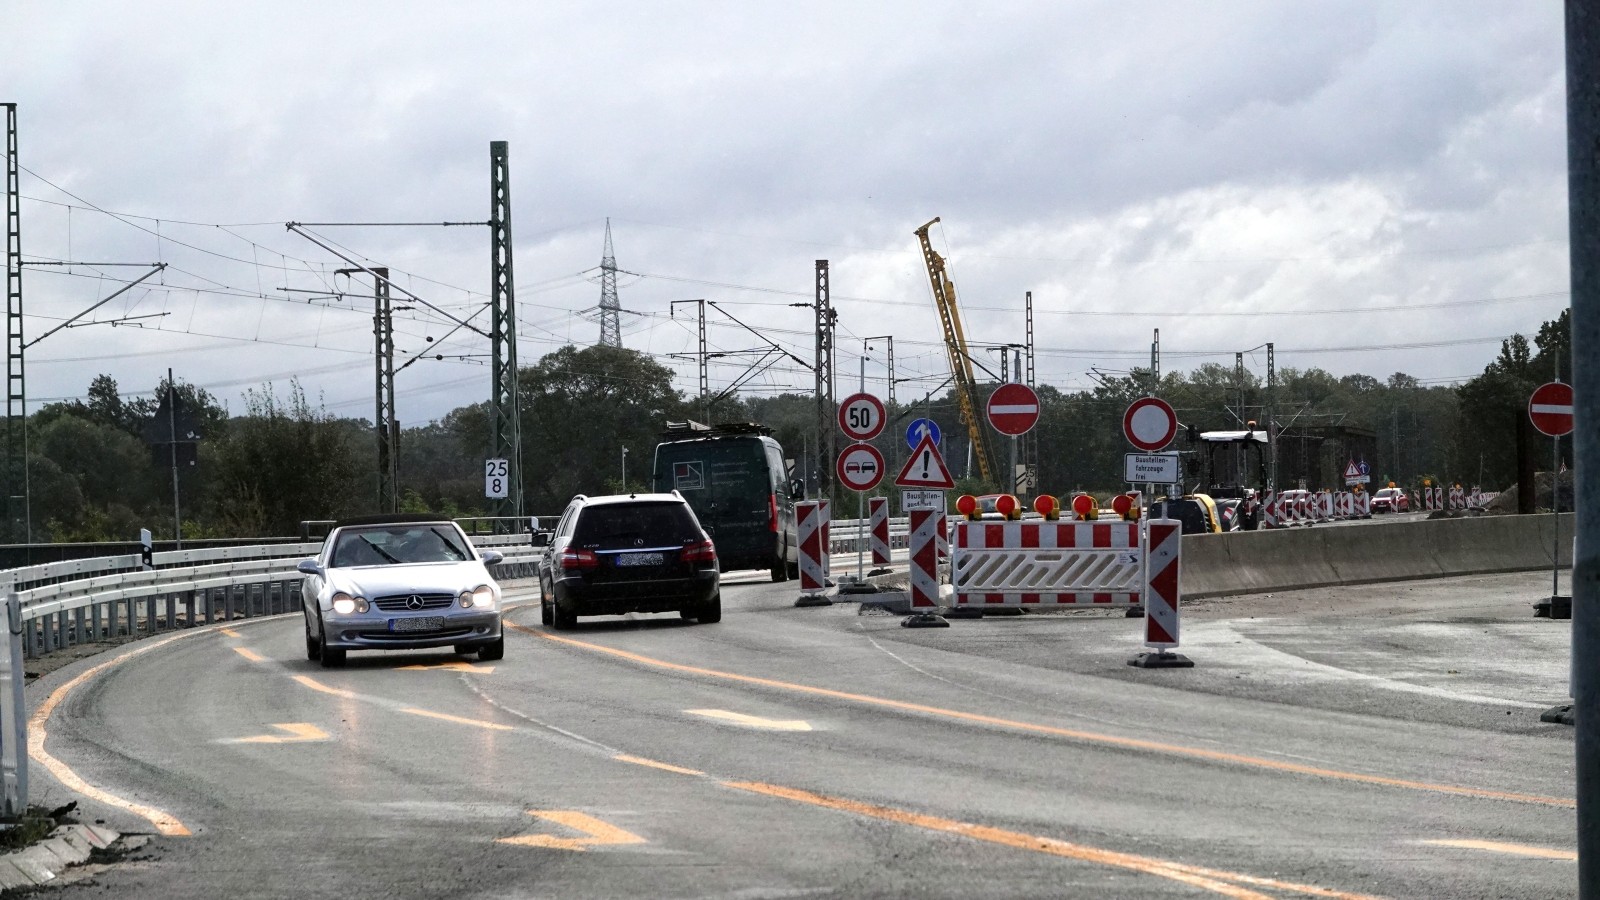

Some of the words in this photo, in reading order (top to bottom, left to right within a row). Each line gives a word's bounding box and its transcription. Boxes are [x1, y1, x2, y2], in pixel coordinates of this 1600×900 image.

[850, 408, 870, 428] 50
[487, 462, 507, 476] 25
[1136, 465, 1164, 474] fahrzeuge
[492, 478, 502, 493] 8
[1026, 478, 1032, 486] 6
